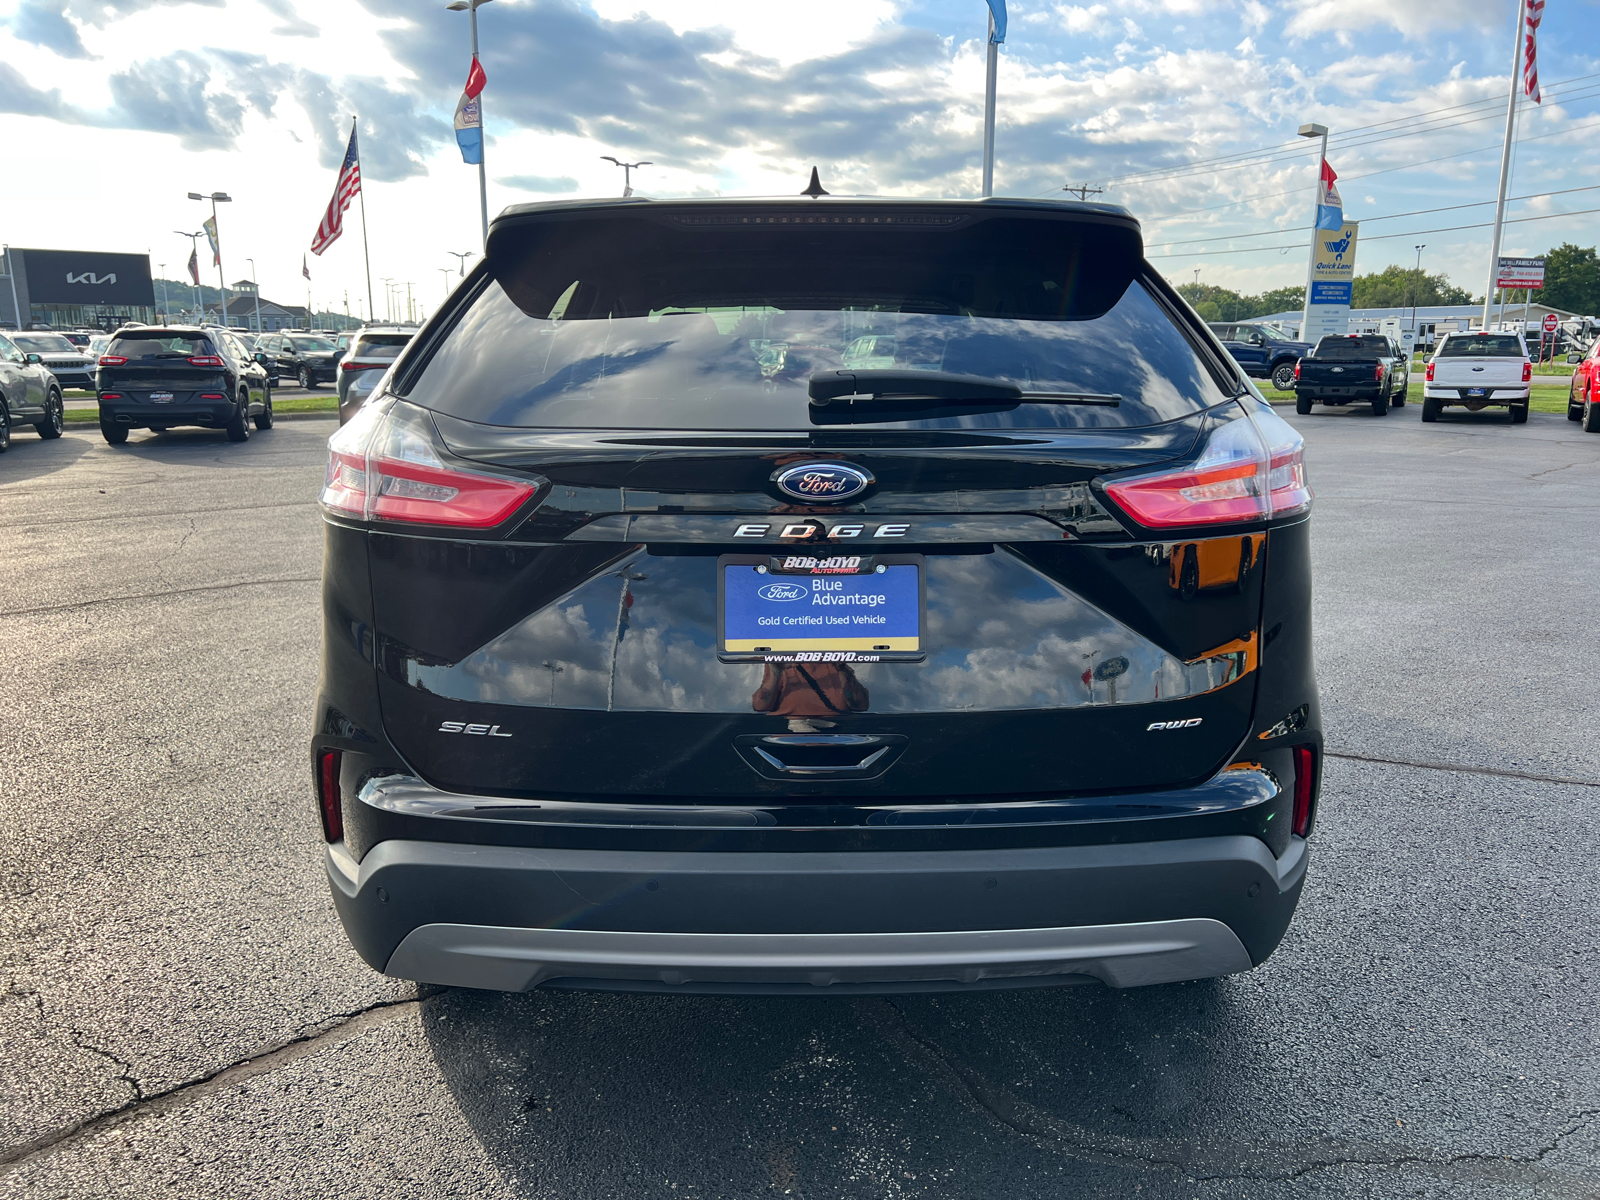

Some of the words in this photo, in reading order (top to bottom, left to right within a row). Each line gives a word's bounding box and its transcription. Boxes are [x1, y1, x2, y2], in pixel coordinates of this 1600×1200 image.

[800, 472, 846, 494] Ford
[732, 524, 911, 538] EDGE
[767, 585, 798, 599] Ford
[812, 579, 842, 591] Blue
[812, 593, 886, 607] Advantage
[758, 616, 780, 626] Gold
[783, 616, 823, 625] Certified
[825, 615, 849, 624] Used
[852, 615, 886, 624] Vehicle
[438, 721, 513, 737] SEL
[1146, 717, 1203, 732] AWD
